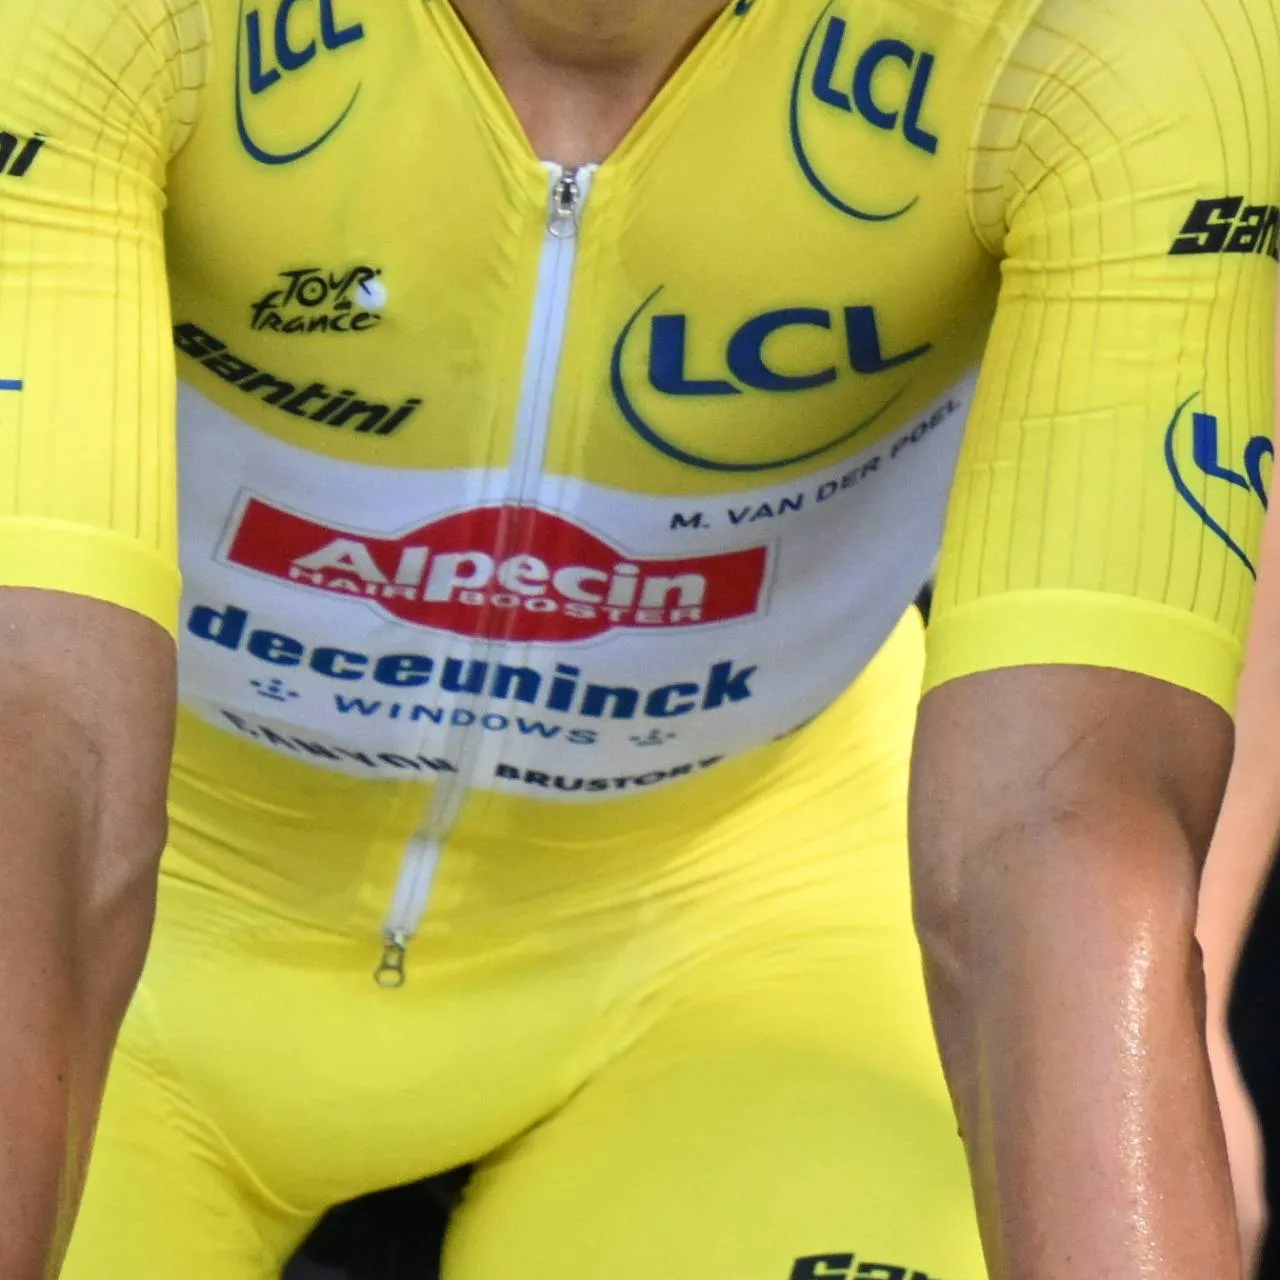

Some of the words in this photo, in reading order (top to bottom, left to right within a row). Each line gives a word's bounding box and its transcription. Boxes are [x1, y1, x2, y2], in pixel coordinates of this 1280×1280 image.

[811, 15, 939, 157] LCL
[173, 321, 424, 436] Santini
[648, 305, 933, 396] LCL
[669, 511, 711, 530] M.
[726, 492, 804, 526] VAN
[816, 456, 882, 504] DER
[890, 399, 962, 459] POEL
[288, 564, 418, 602] HAIR
[459, 590, 702, 625] BOOSTER
[290, 537, 708, 609] Alpecin
[187, 604, 759, 720] deceuninck
[220, 708, 458, 774] CANYON
[333, 693, 599, 746] WINDOWS
